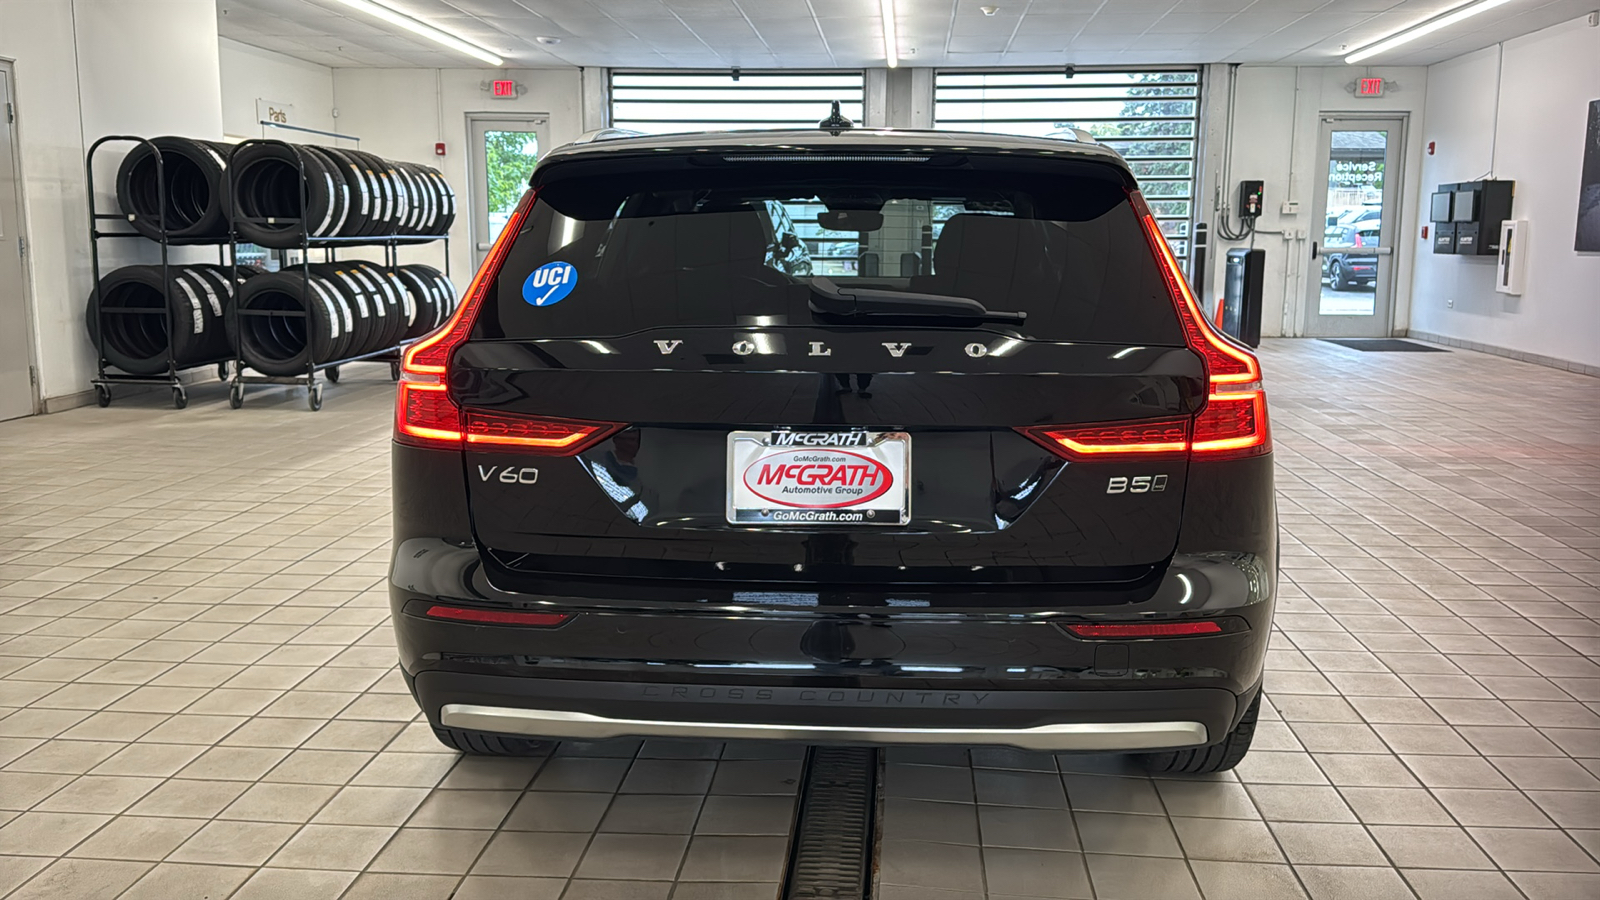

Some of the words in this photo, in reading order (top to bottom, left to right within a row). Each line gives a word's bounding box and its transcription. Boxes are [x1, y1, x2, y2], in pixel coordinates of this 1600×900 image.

[493, 80, 513, 96] EXIT
[1361, 78, 1382, 94] EXIT
[268, 107, 287, 123] Parts
[532, 265, 572, 288] UCI
[653, 339, 988, 358] VOLVO
[793, 455, 846, 463] GoMcGrath.com
[781, 486, 833, 495] Automotive
[835, 486, 863, 496] Group
[1106, 476, 1152, 494] B5
[773, 511, 863, 522] GoMcGrath.com
[643, 685, 773, 700] CROSS
[800, 689, 990, 705] COUNTRY
